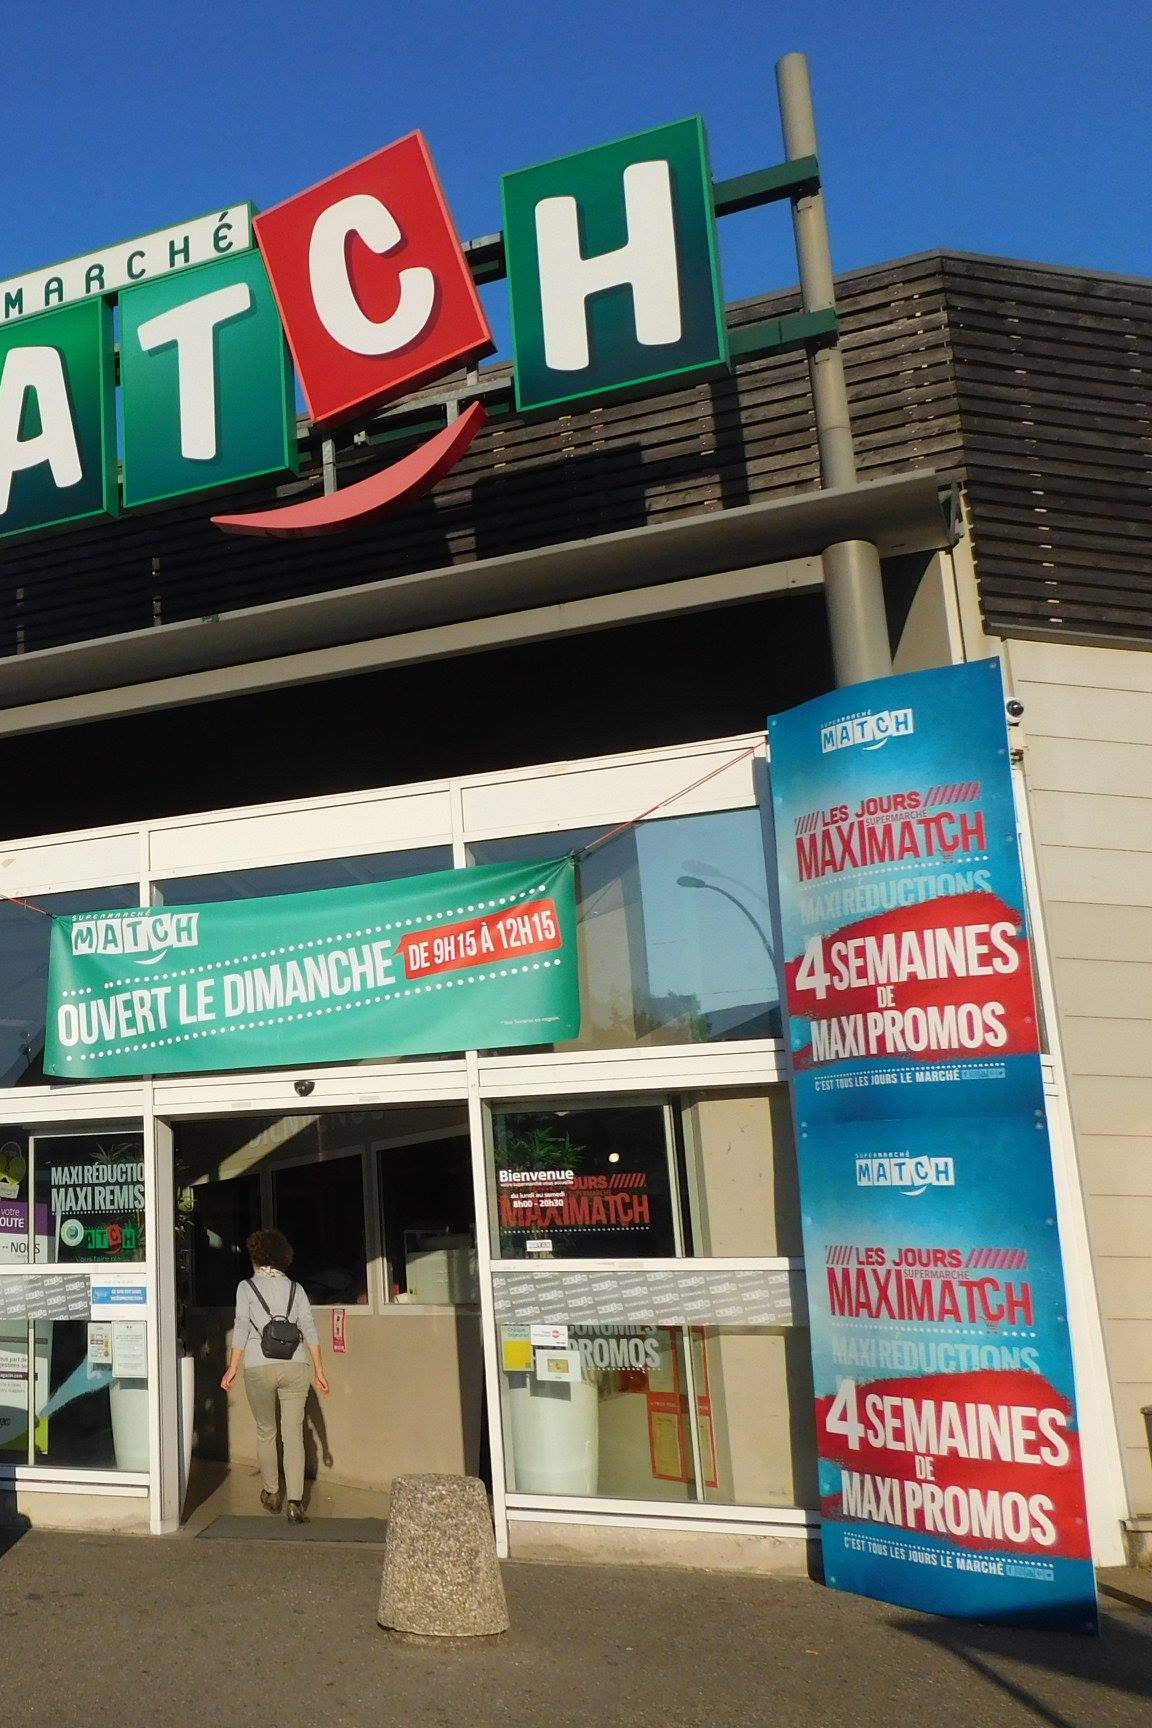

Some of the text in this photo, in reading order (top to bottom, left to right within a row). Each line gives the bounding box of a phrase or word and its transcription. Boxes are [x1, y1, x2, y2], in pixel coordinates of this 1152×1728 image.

[822, 712, 910, 751] MATCH
[821, 791, 921, 827] LES JOURS
[795, 811, 987, 882] MAXIMATCH
[73, 914, 196, 952] MATCH
[795, 922, 1019, 1000] 4 SEMAINES
[57, 986, 172, 1047] OUVERT
[179, 978, 216, 1025] LE
[223, 939, 396, 1018] DIMANCHE
[407, 943, 430, 972] DE
[481, 921, 495, 953] À
[876, 985, 895, 1008] DE
[810, 1001, 1008, 1062] MAXI PROMOS
[871, 1072, 898, 1086] JOURS
[900, 1072, 913, 1084] LE
[915, 1068, 960, 1082] MARCHÉ
[51, 1166, 85, 1186] MAXI
[499, 1169, 575, 1183] Bienvenue
[857, 1159, 951, 1183] MATCH
[1, 1208, 20, 1216] votre
[51, 1187, 94, 1212] MAXI
[539, 1199, 564, 1207] 20h30
[856, 1247, 962, 1268] LES JOURS
[826, 1266, 1033, 1327] MAXIMATCH
[825, 1378, 1070, 1467] 4 SEMAINES
[915, 1456, 935, 1481] DE
[841, 1469, 1057, 1546] MAXI PROMOS
[868, 1541, 888, 1556] TOUS
[890, 1546, 906, 1560] LES
[908, 1550, 938, 1566] JOURS
[940, 1555, 953, 1569] LE
[956, 1557, 1004, 1576] MARCHÉ
